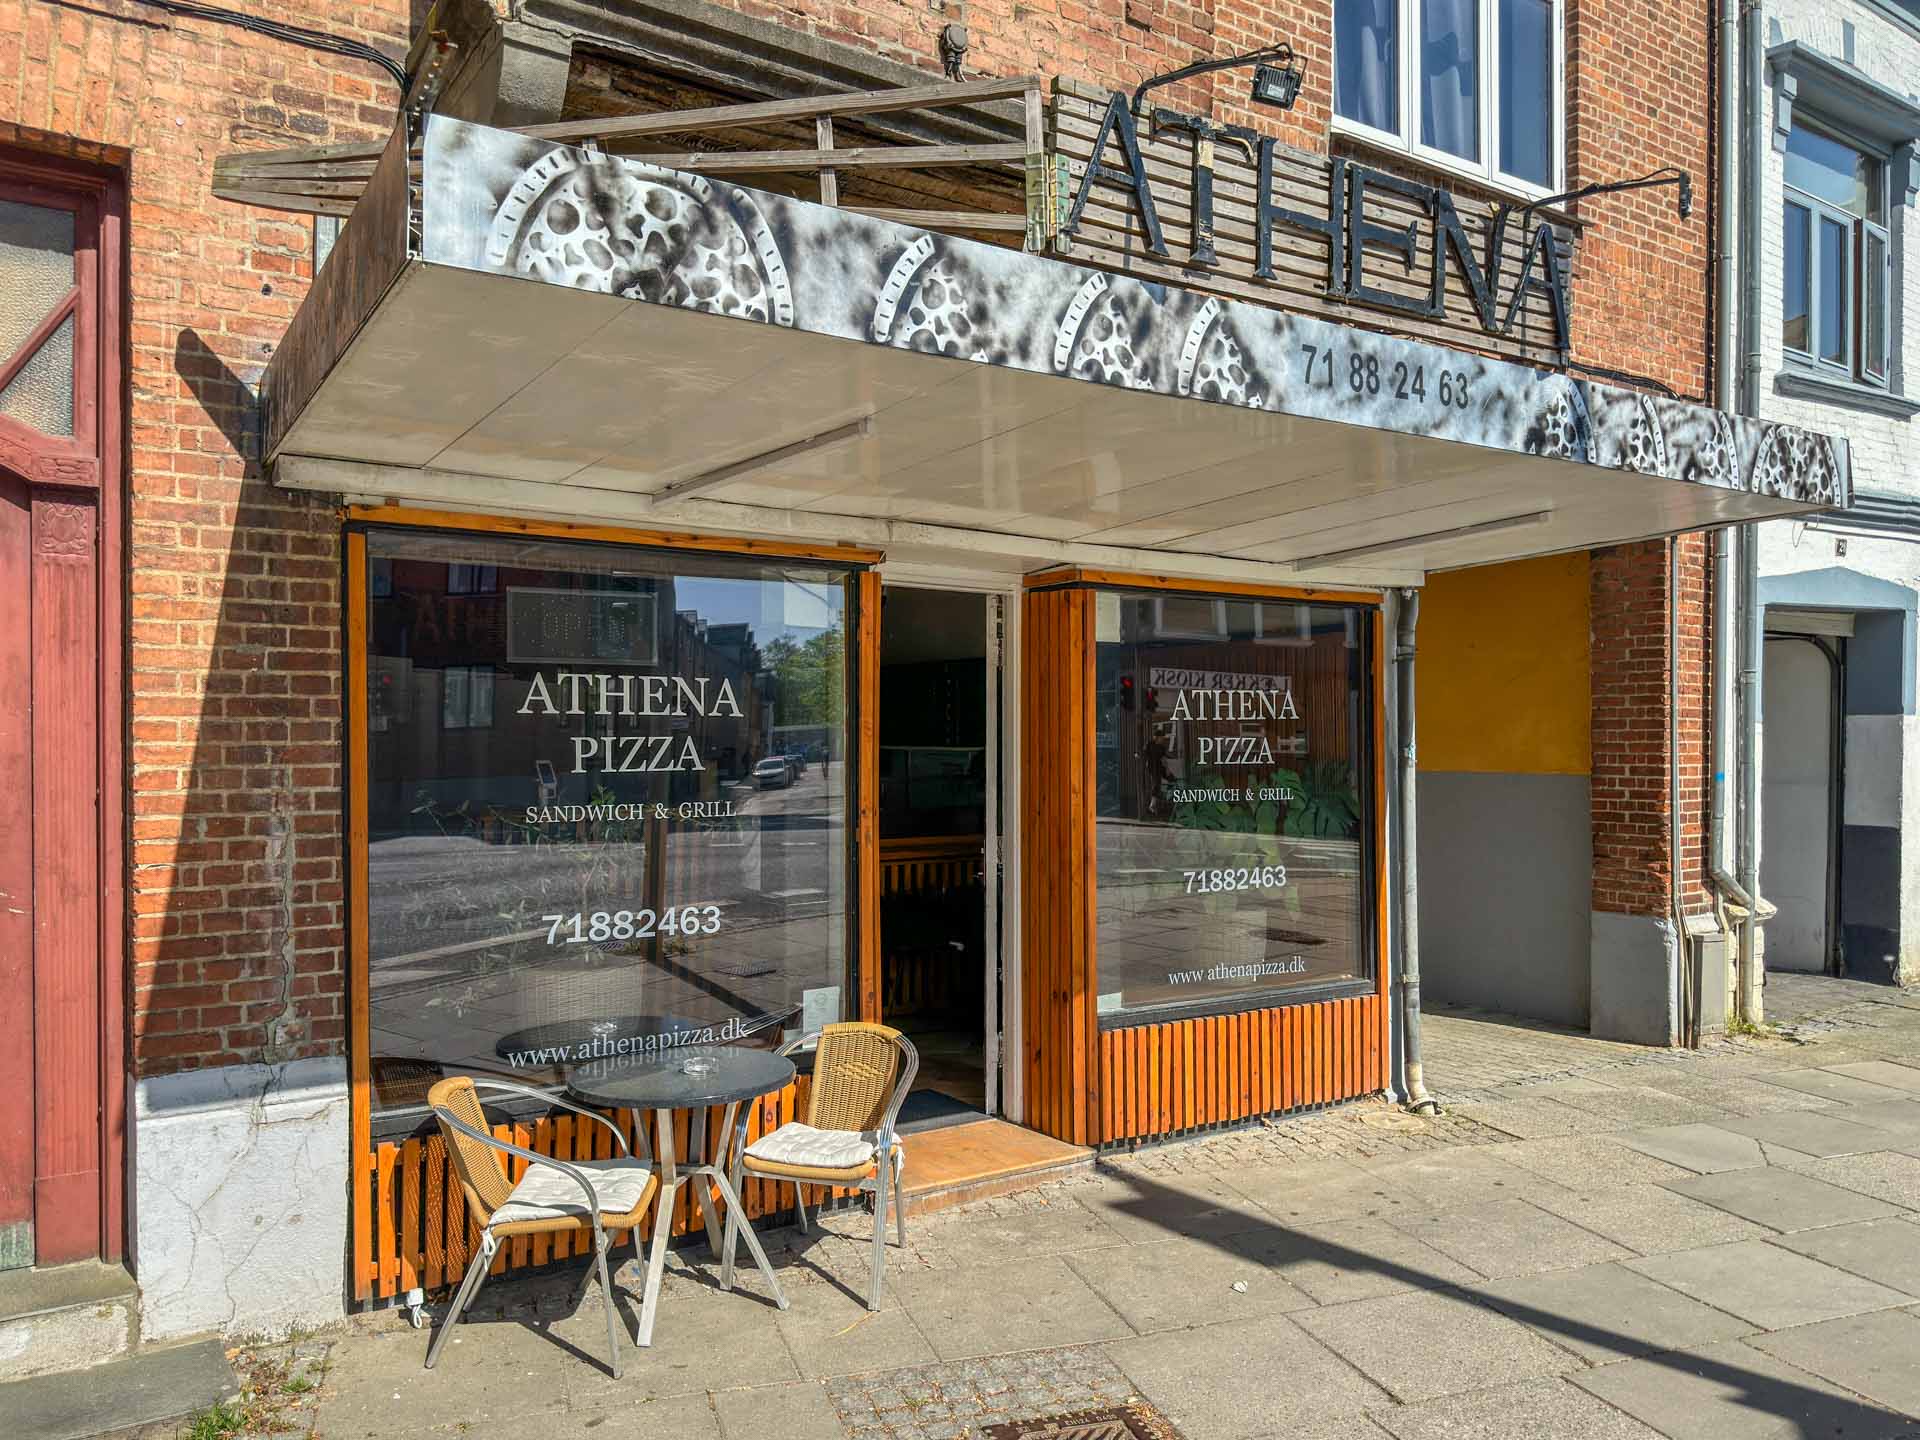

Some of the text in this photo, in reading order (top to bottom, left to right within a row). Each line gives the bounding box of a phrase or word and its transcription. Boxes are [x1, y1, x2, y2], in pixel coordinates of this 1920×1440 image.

[1061, 91, 1571, 350] ATHENA
[1302, 344, 1469, 409] 71 88 24 63
[516, 671, 744, 718] ATHENA
[1169, 688, 1300, 721] ATHENA
[570, 735, 706, 774] PIZZA
[1197, 737, 1275, 765] PIZZA
[526, 800, 737, 824] SANDWICH & GRILL
[1173, 787, 1294, 803] SANDWICH & GRILL
[1183, 865, 1287, 894] 71882463
[541, 905, 721, 944] 71882463
[507, 1017, 748, 1069] www.athenapizza.dk
